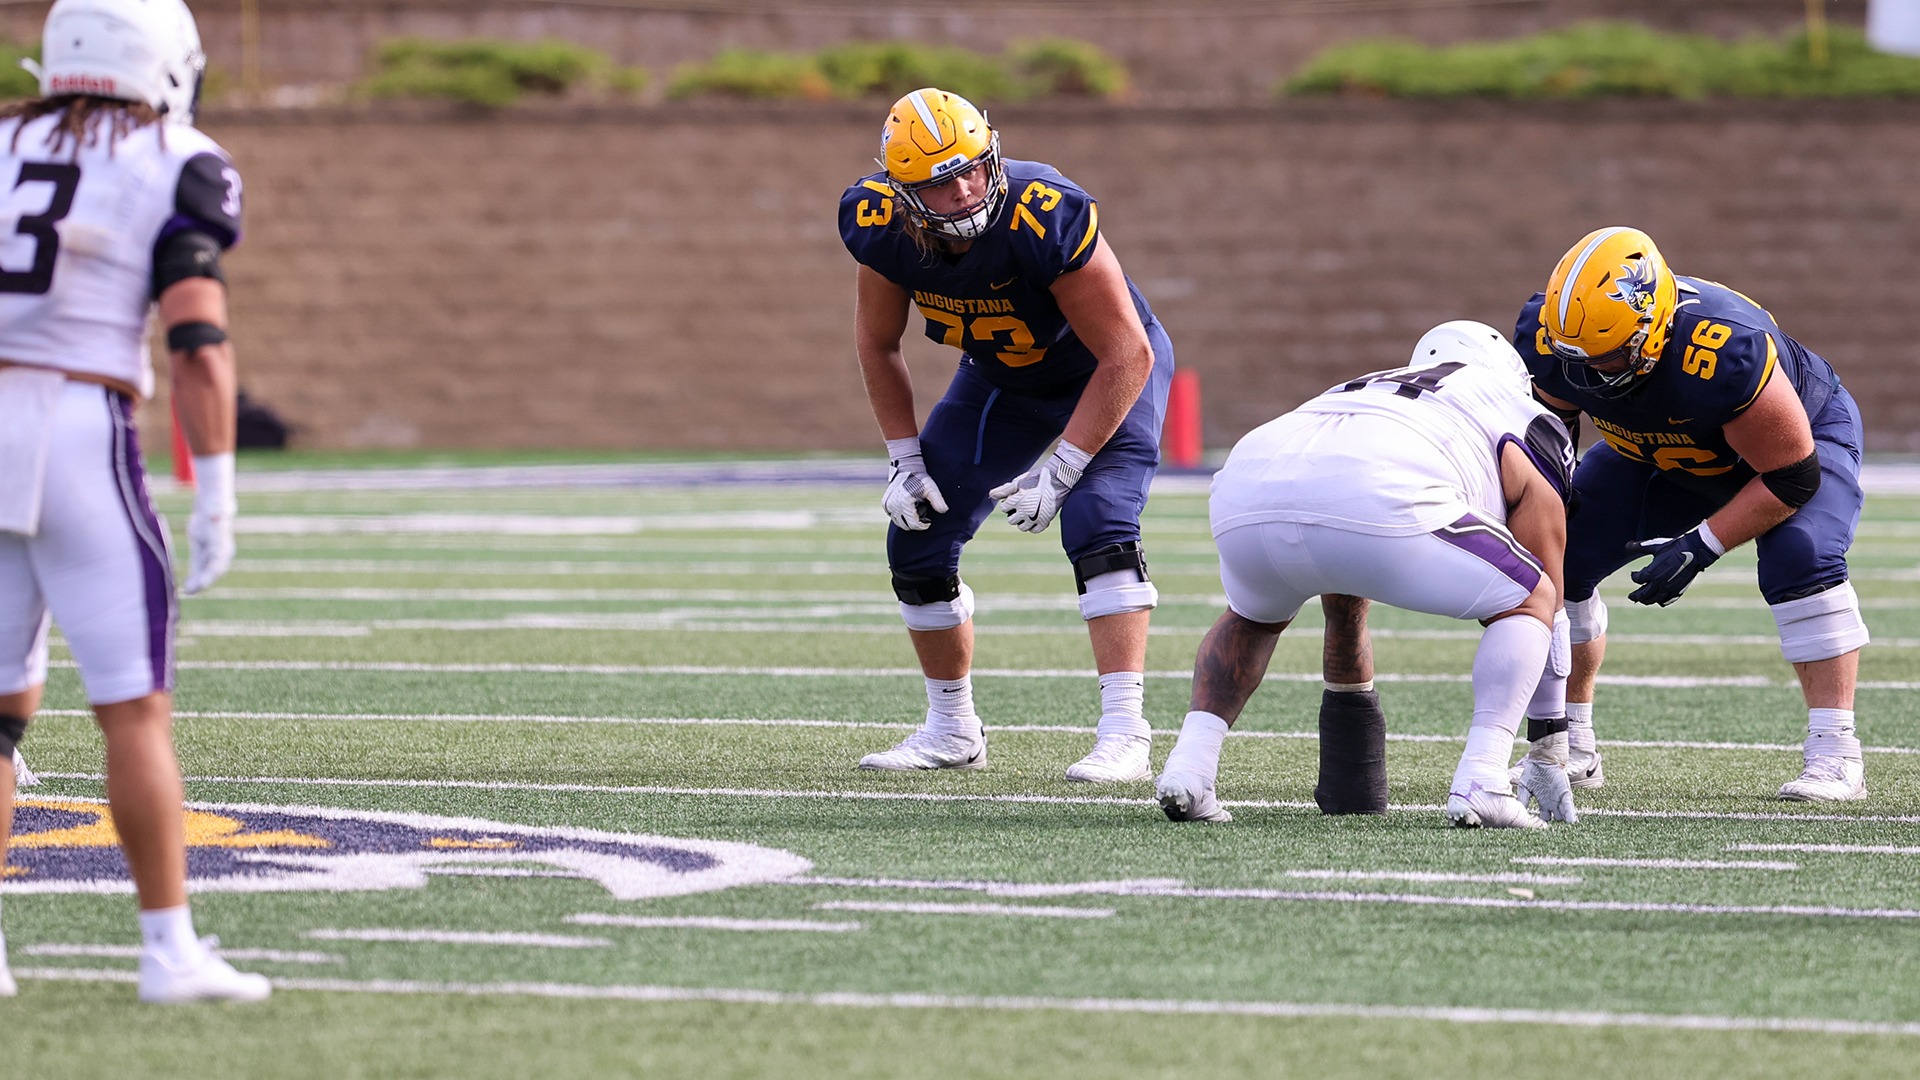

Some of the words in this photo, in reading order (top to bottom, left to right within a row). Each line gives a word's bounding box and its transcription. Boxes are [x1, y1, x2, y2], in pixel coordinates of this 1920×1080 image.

[221, 167, 243, 217] 3
[1010, 181, 1063, 240] 73
[0, 162, 81, 294] 3
[914, 289, 1015, 314] AUGUSTANA
[1682, 319, 1733, 381] 56
[1592, 416, 1697, 445] AUGUSTANA
